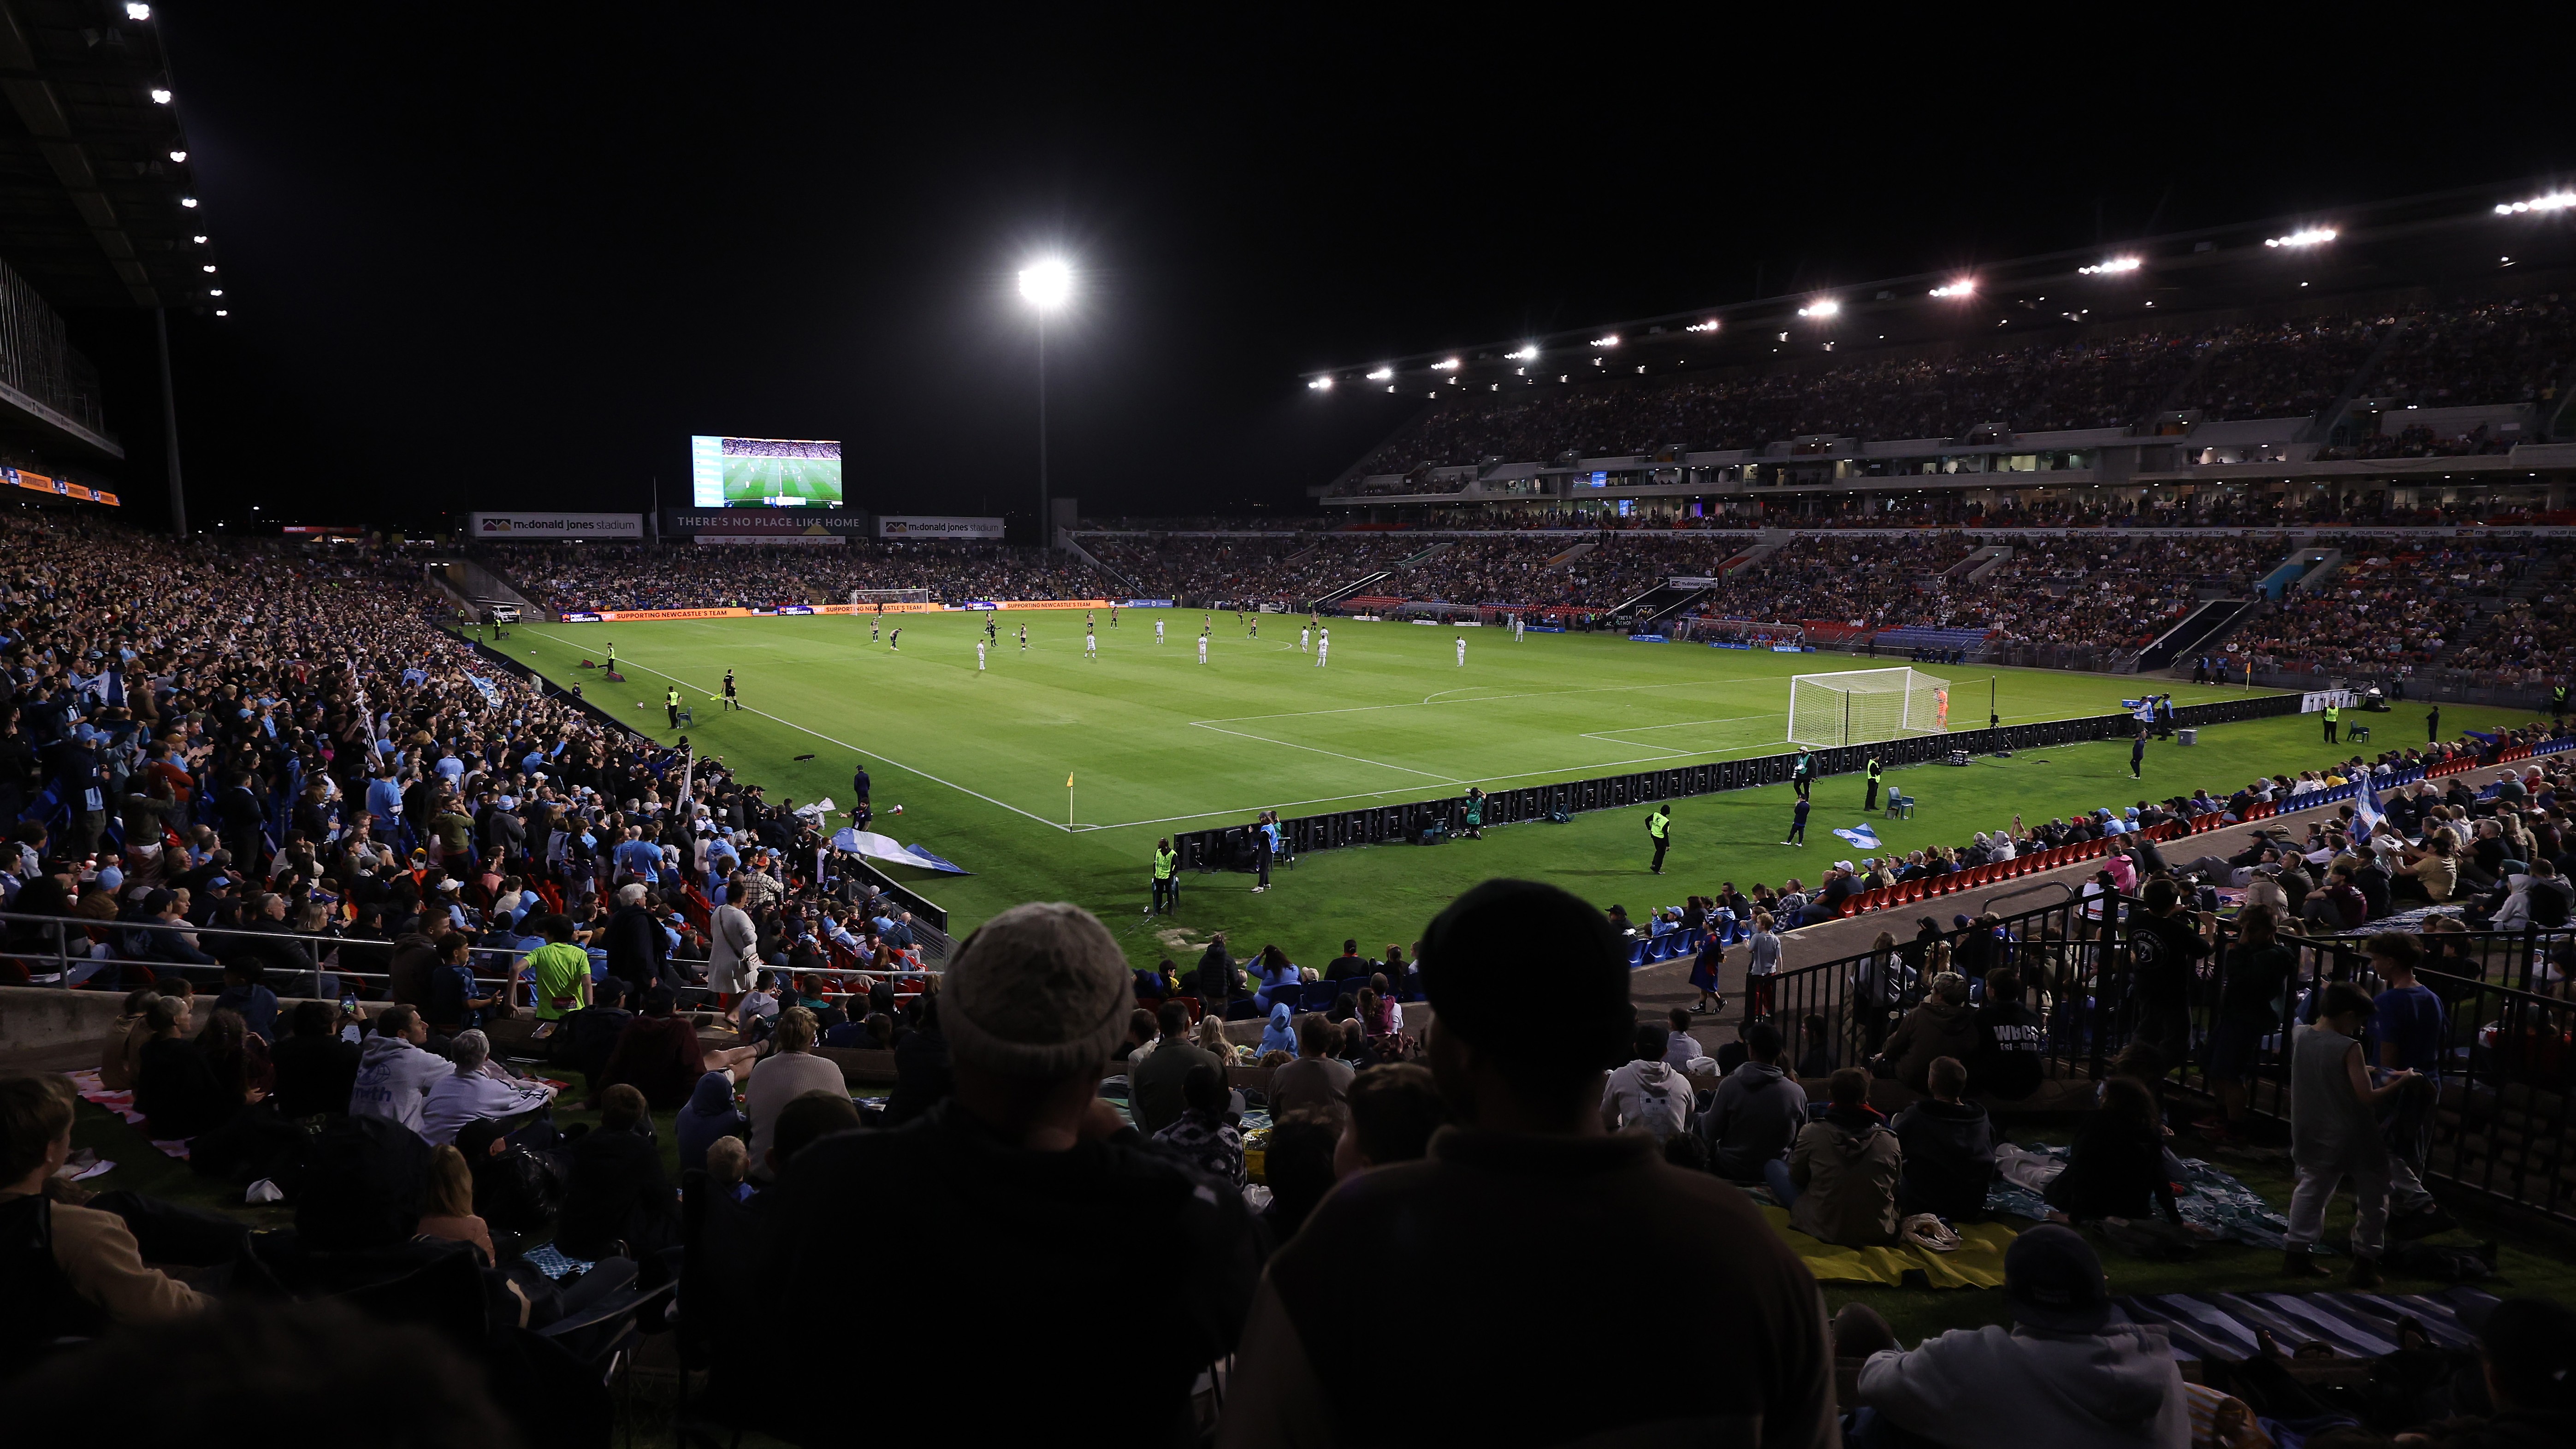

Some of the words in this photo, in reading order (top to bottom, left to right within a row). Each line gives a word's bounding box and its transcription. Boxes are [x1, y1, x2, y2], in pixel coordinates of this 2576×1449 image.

[514, 520, 563, 529] mcdonald
[566, 520, 594, 531] jones
[597, 520, 634, 529] stadium
[678, 517, 728, 526] THERE'S
[733, 517, 751, 526] NO
[755, 518, 792, 526] PLACE
[796, 518, 821, 526] LIKE
[825, 518, 859, 527] HOME
[947, 523, 968, 532] jones
[1993, 1024, 2039, 1041] WBCC
